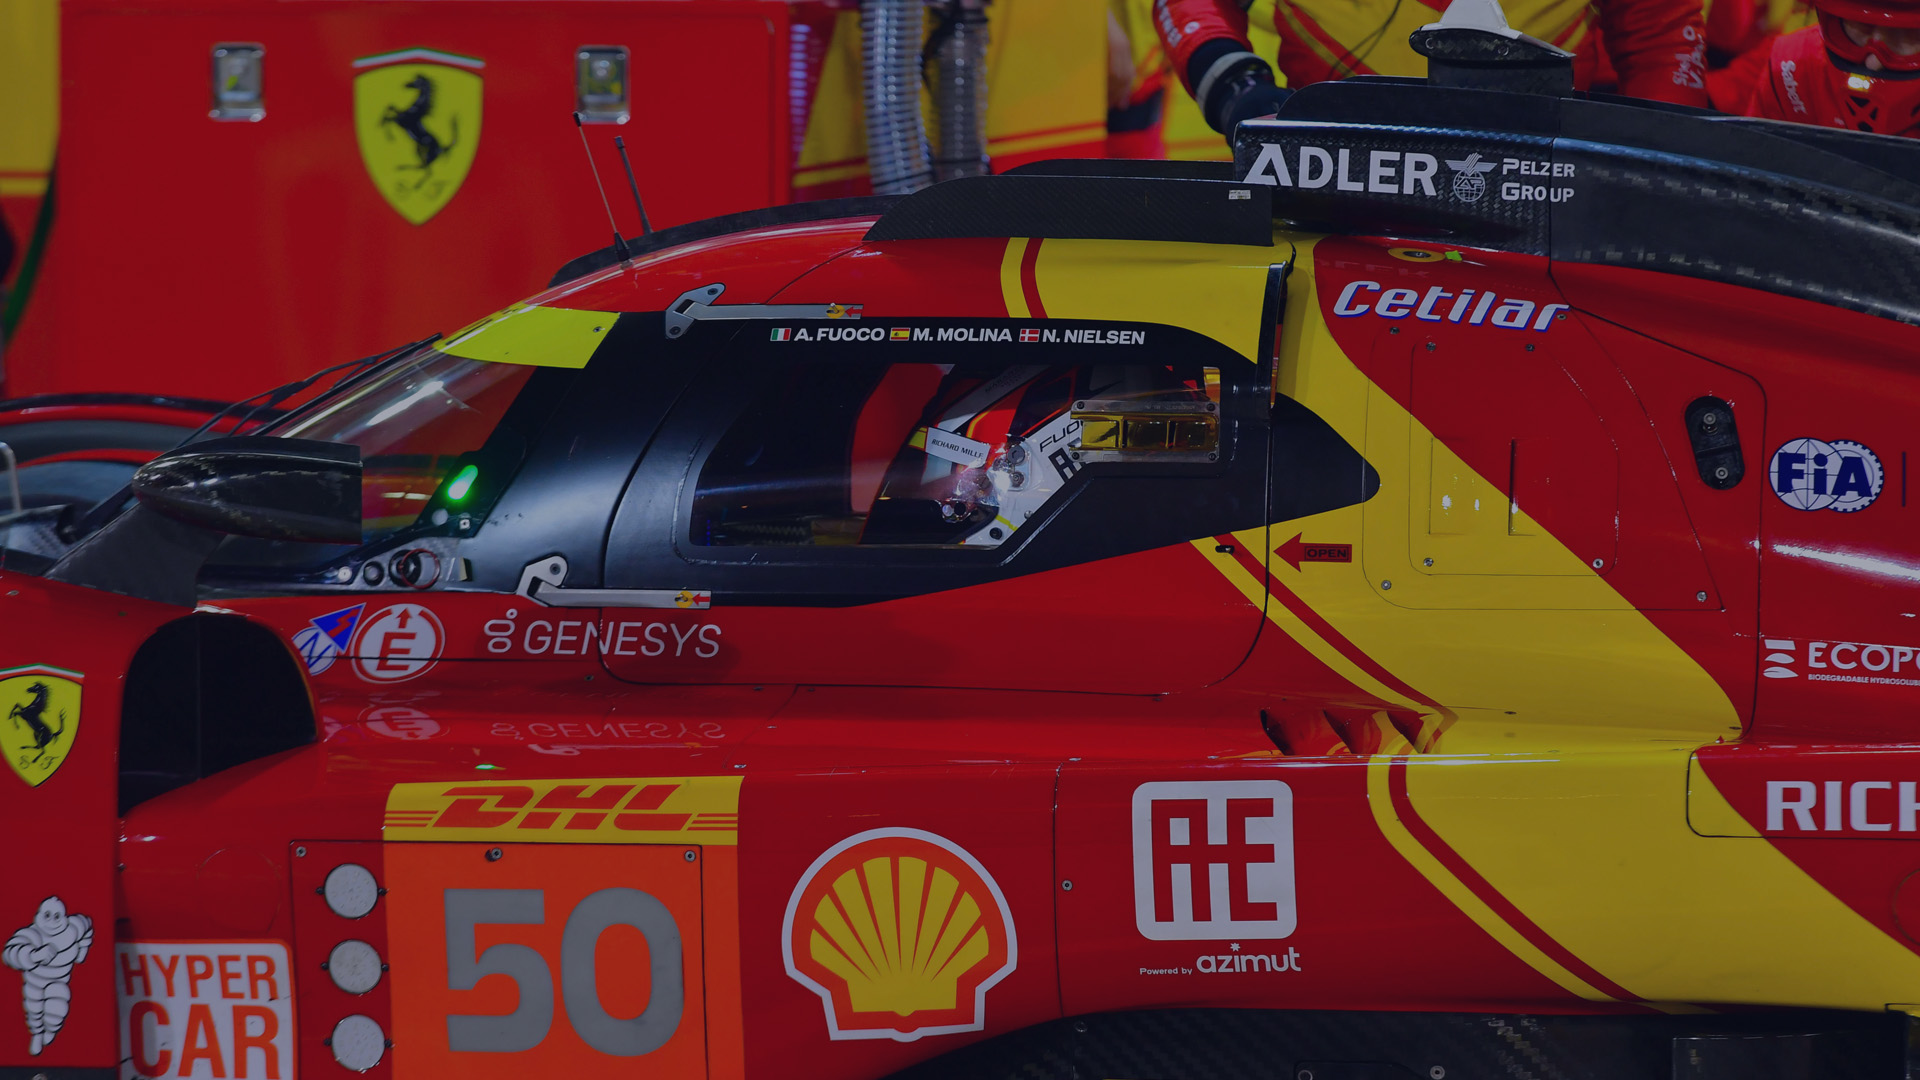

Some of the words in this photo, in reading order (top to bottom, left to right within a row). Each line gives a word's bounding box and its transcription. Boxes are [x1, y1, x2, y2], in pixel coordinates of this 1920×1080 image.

[1243, 142, 1437, 196] ADLER
[1502, 157, 1576, 178] PELZER
[1501, 182, 1575, 203] GROUP
[1333, 280, 1571, 332] Cetilar
[793, 327, 814, 342] A.
[816, 327, 885, 342] FUOCO
[913, 327, 934, 342] M.
[937, 328, 1012, 343] MOLINA
[1042, 329, 1060, 344] N.
[1063, 330, 1145, 345] NIELSEN
[931, 438, 960, 452] RICHARD
[1039, 420, 1083, 453] FUO
[1307, 548, 1347, 558] OPEN
[523, 620, 722, 659] GENESYS
[1808, 641, 1920, 673] ECOP
[1807, 673, 1870, 684] BIODEGRADABLE
[431, 783, 694, 831] DHL
[119, 952, 279, 1000] HYPER
[443, 886, 685, 1058] 50
[1139, 967, 1179, 975] Powered
[1181, 966, 1193, 976] by
[1196, 944, 1302, 974] azimut
[129, 1000, 281, 1080] CAR
